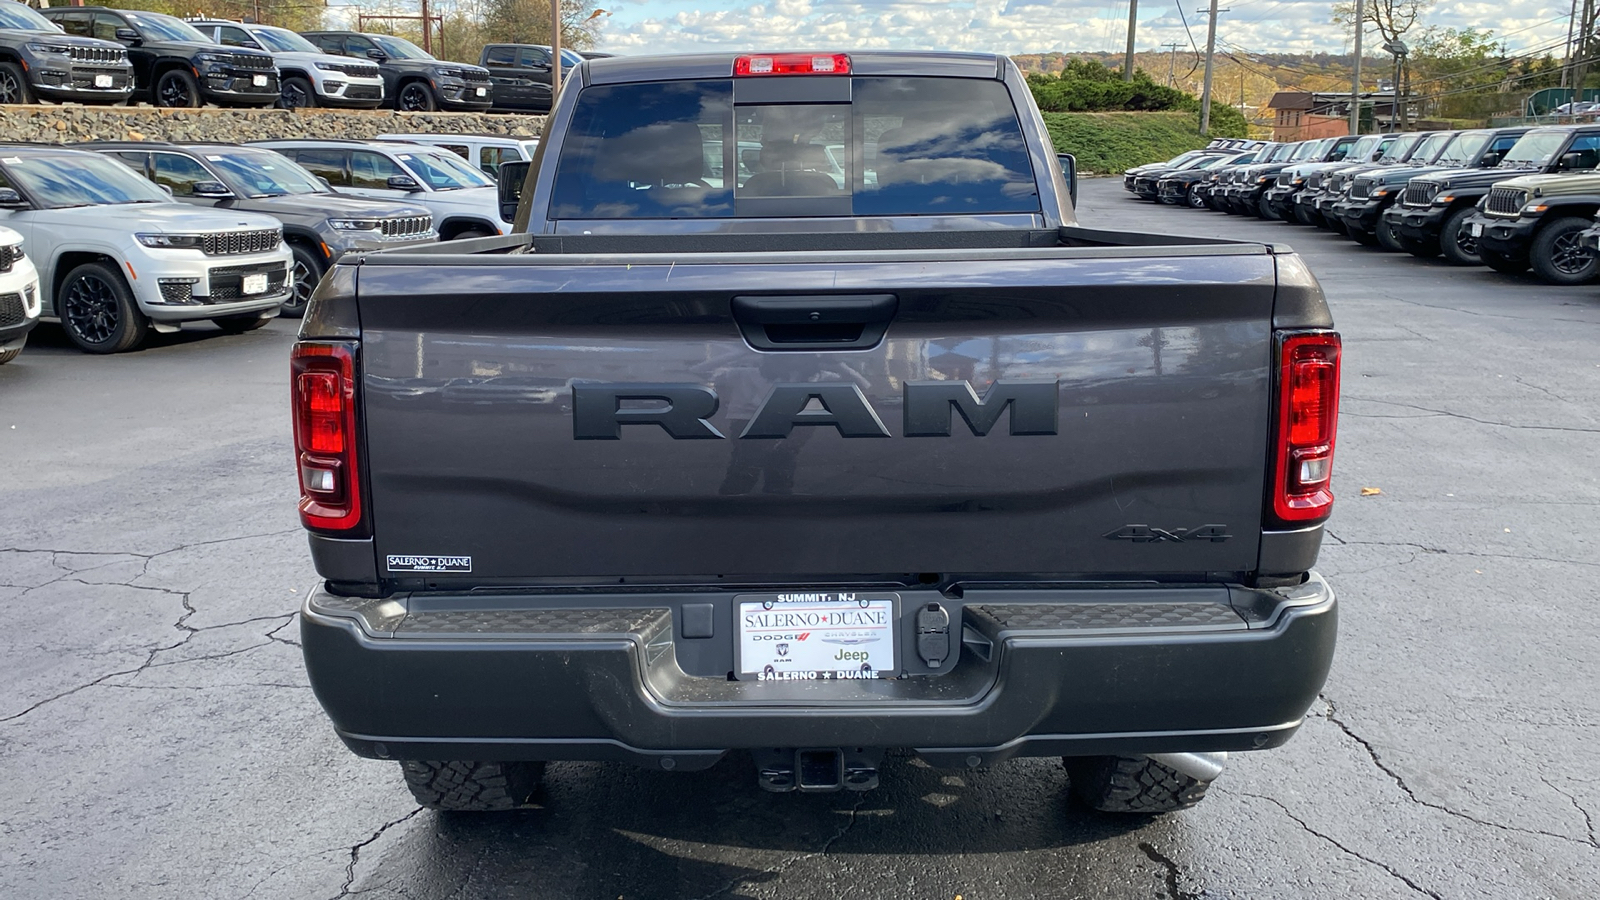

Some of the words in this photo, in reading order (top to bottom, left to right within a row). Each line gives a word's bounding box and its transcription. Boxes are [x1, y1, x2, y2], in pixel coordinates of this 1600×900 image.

[571, 379, 1060, 440] RAM
[389, 557, 429, 566] SALERNO
[438, 558, 469, 566] DUANE
[839, 593, 856, 601] NJ
[745, 612, 820, 628] SALERNO
[829, 611, 887, 625] DUANE
[834, 648, 869, 662] Jeep
[757, 671, 817, 681] SALERNO
[836, 670, 879, 680] DUANE
